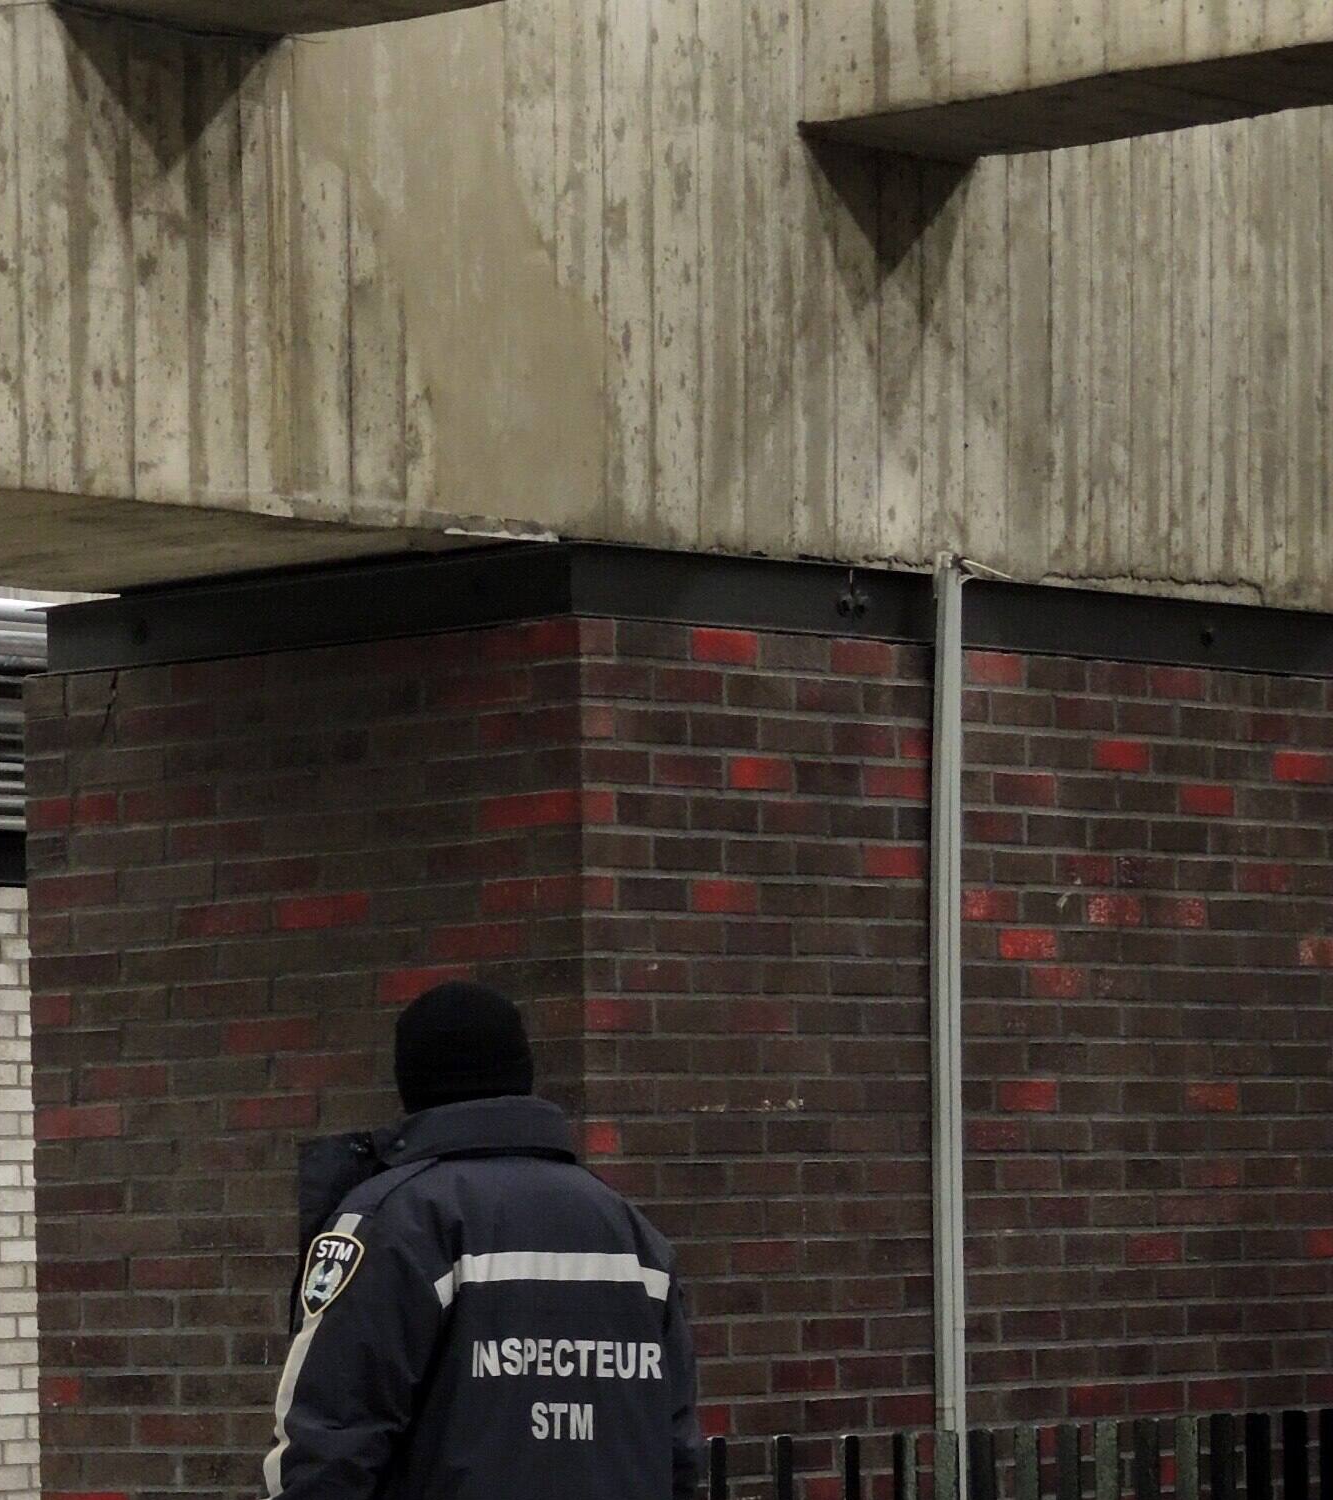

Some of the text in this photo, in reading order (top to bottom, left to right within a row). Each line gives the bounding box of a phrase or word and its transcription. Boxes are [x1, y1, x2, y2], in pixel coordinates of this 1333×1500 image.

[315, 1239, 354, 1262] STM
[472, 1337, 663, 1380] INSPECTEUR
[531, 1401, 594, 1441] STM
